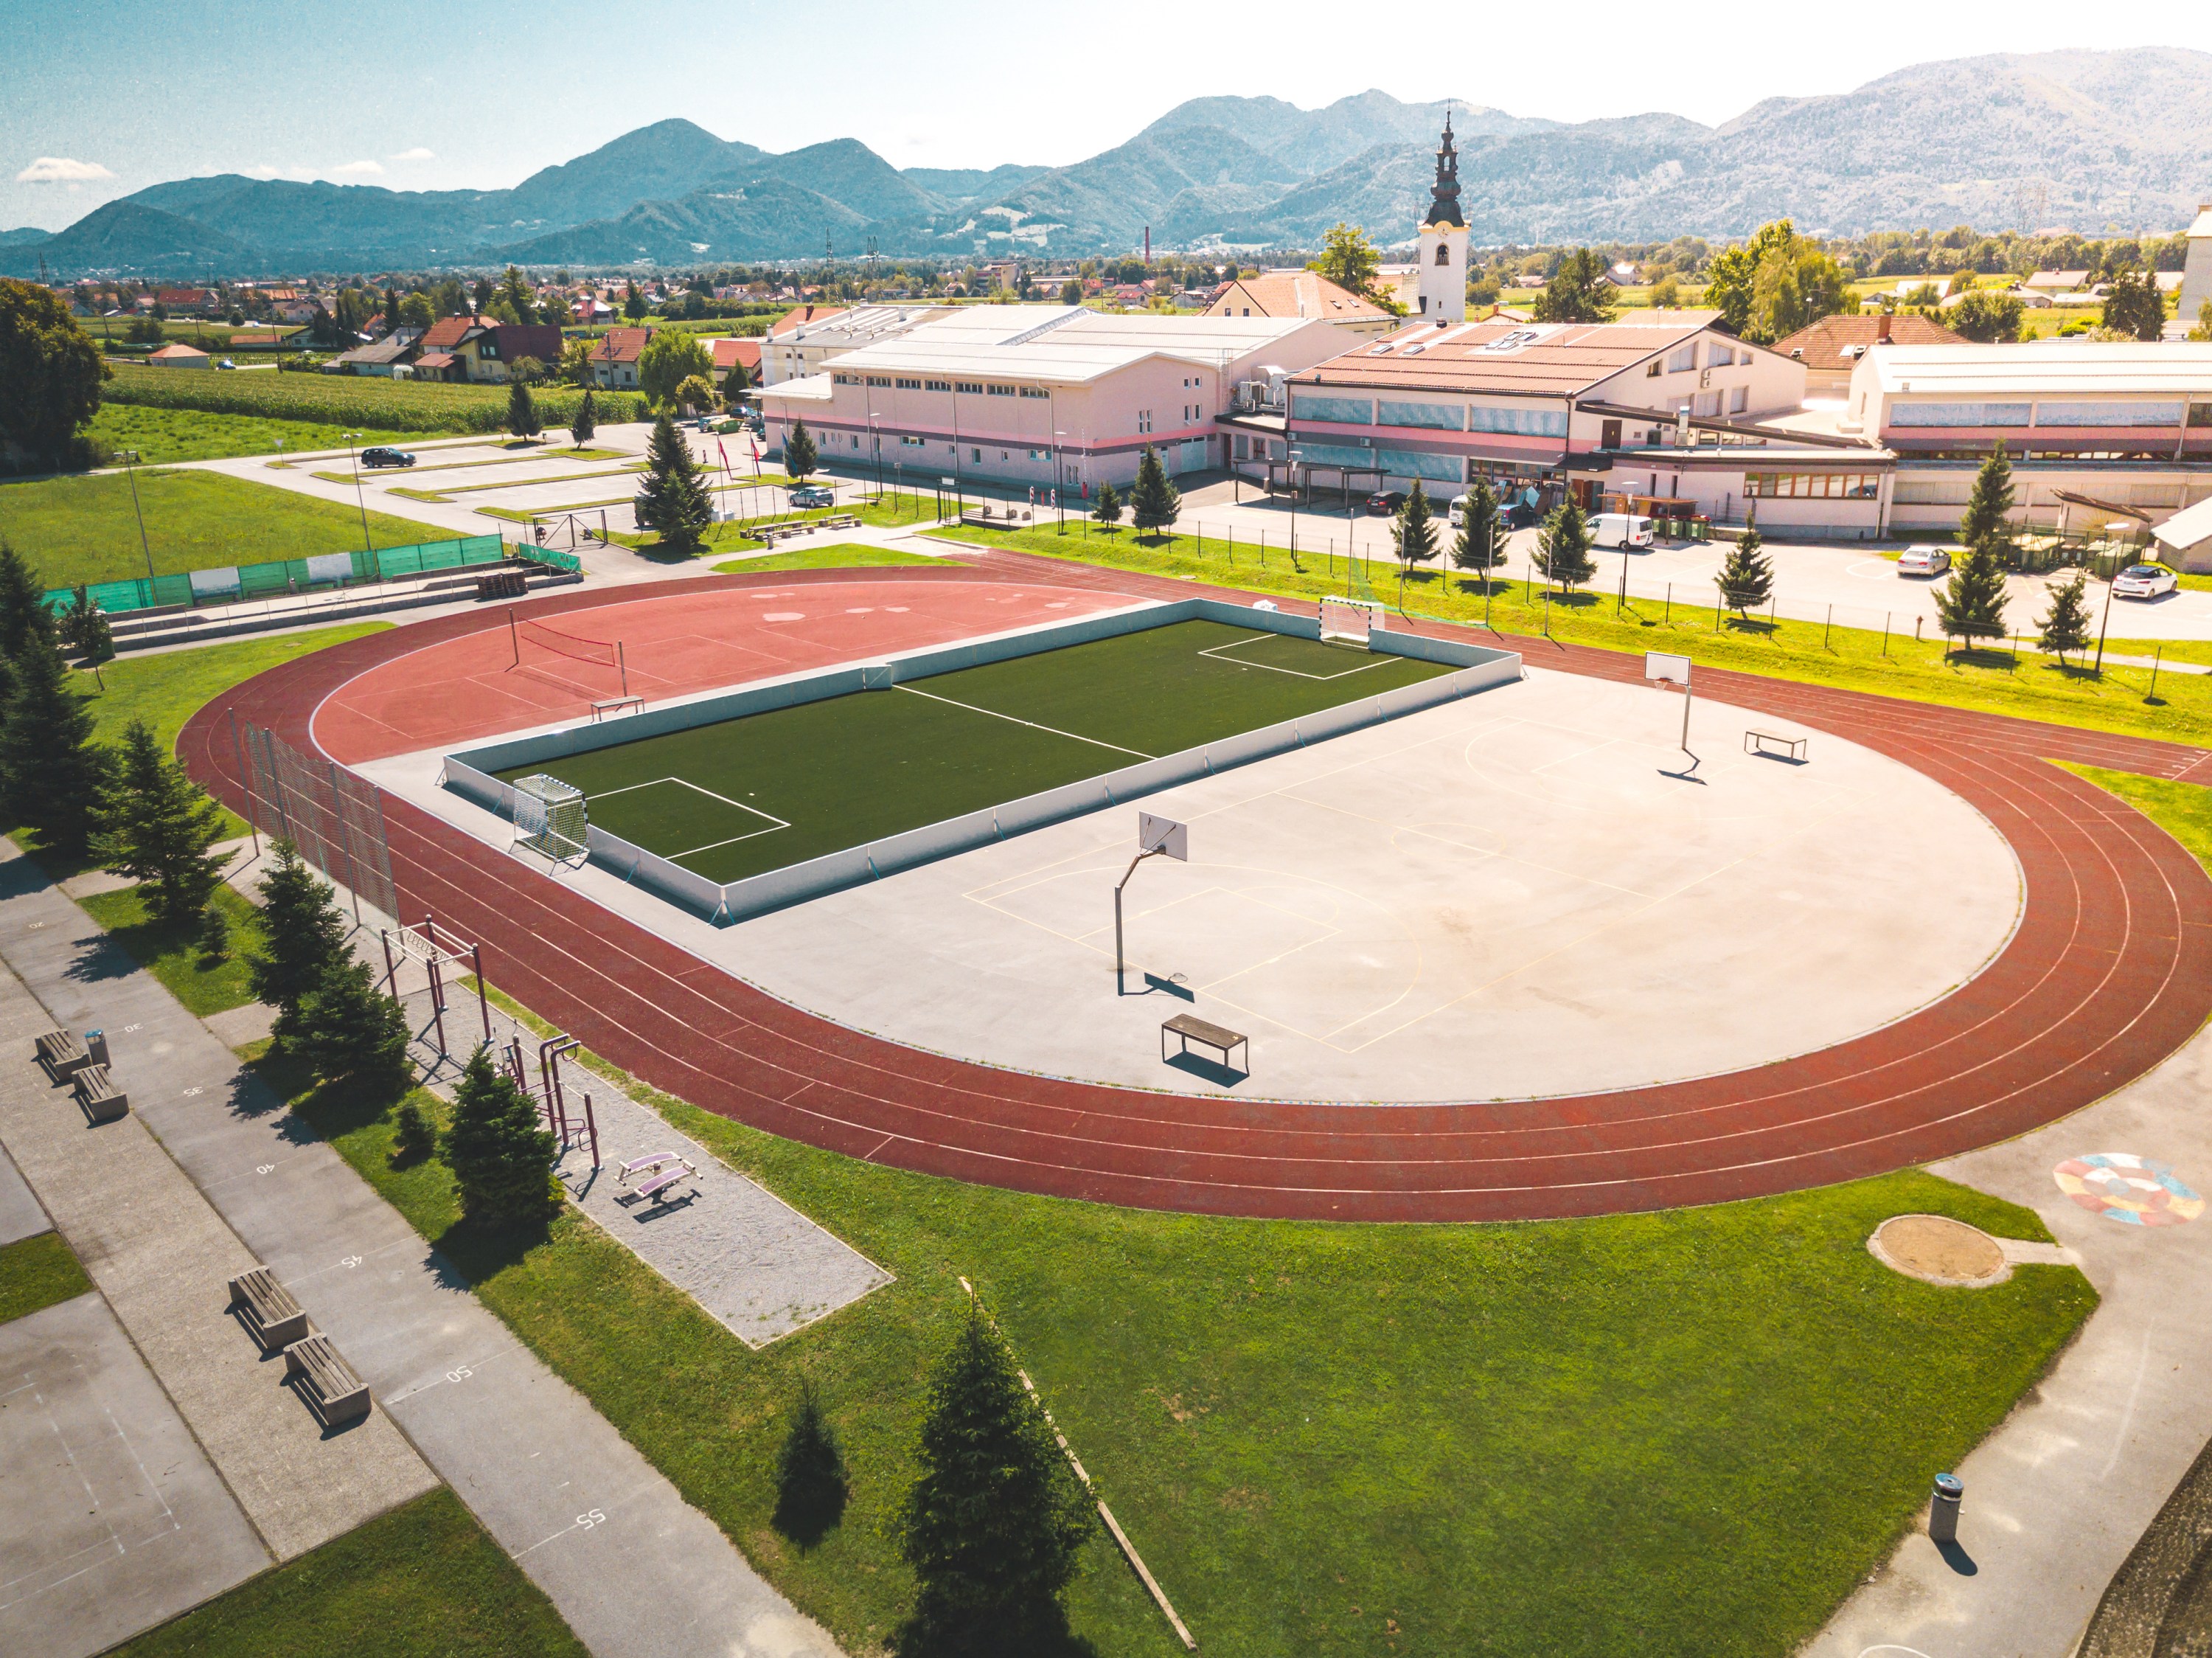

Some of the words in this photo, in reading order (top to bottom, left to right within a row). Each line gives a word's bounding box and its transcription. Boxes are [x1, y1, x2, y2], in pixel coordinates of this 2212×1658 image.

[29, 921, 45, 929] 20
[124, 1023, 144, 1033] 30
[183, 1086, 204, 1097] 35
[256, 1163, 276, 1175] 40
[341, 1255, 362, 1269] 45
[445, 1365, 473, 1382] 50
[576, 1508, 606, 1530] 55
